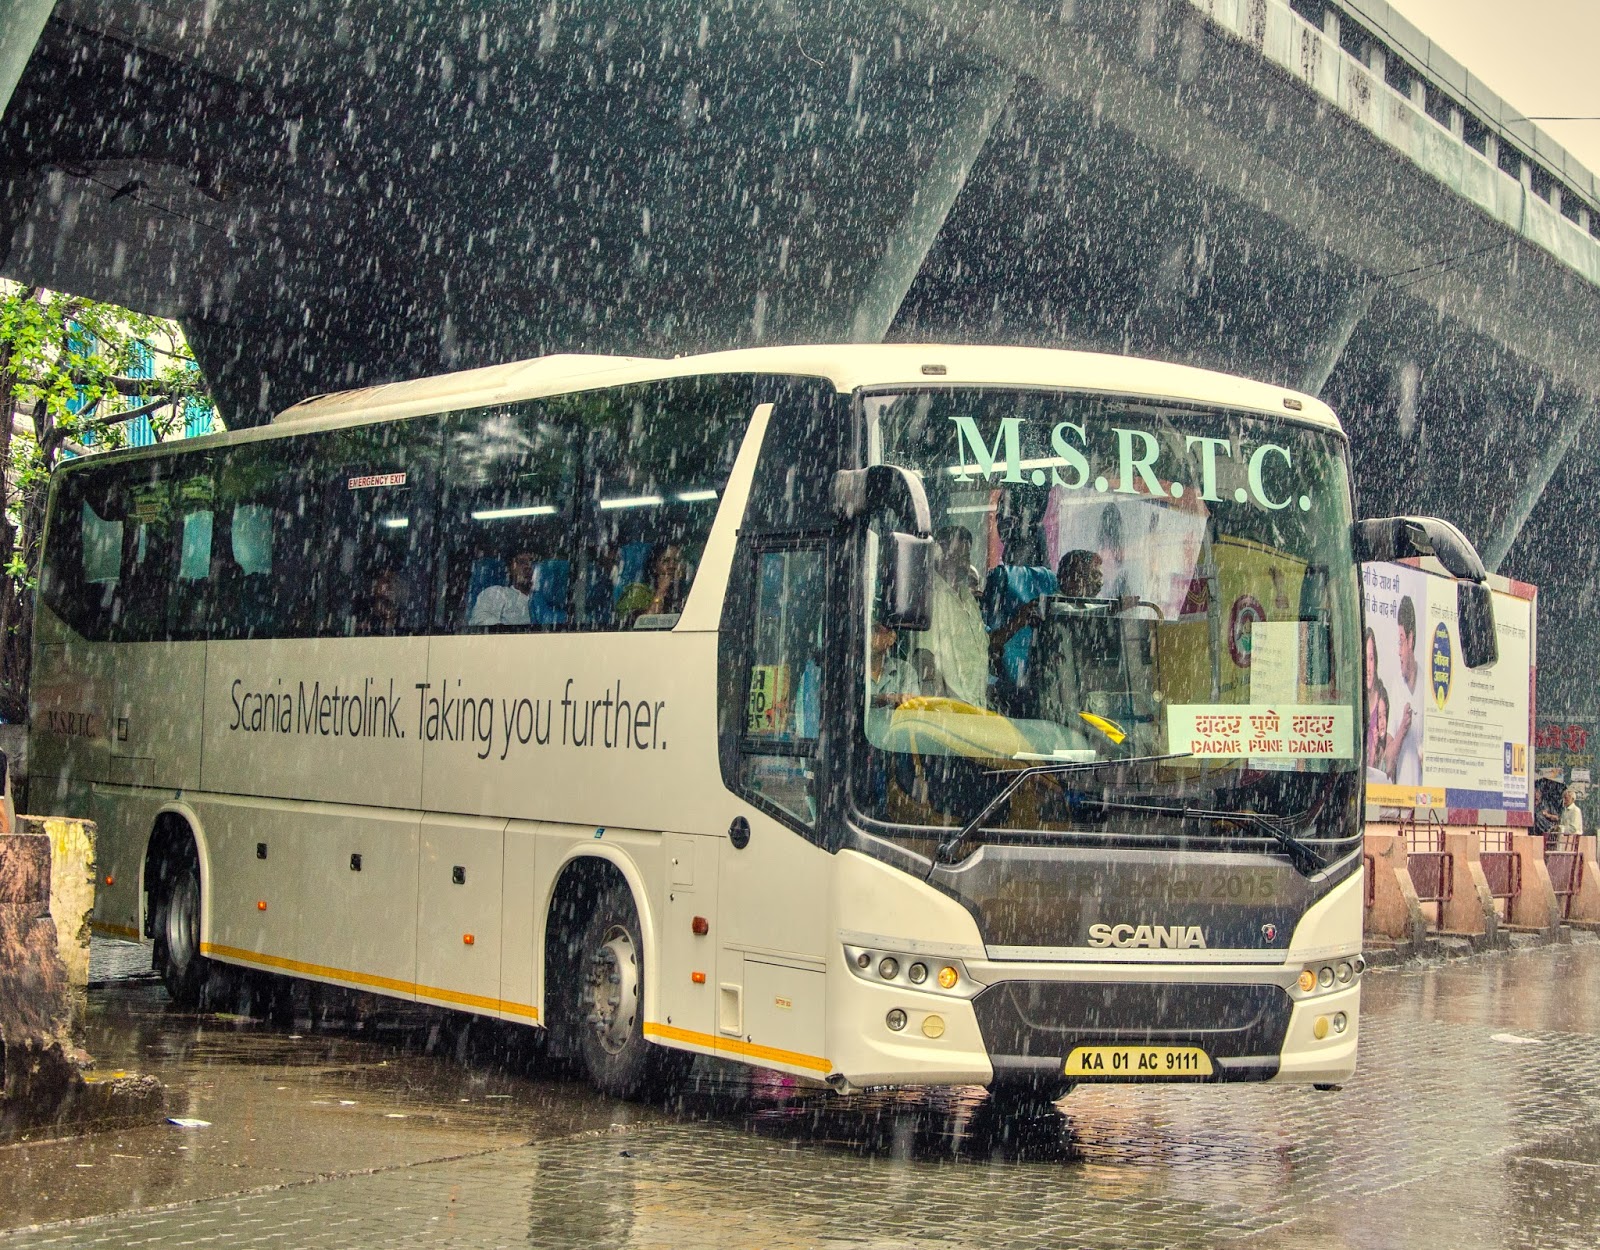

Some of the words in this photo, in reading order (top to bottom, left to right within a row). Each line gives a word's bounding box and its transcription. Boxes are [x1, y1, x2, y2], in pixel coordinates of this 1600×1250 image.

[948, 416, 1311, 511] M.S.R.T.C.
[349, 476, 388, 488] EMERGENCY
[390, 474, 404, 484] EXIT
[1372, 568, 1379, 588] के
[1379, 575, 1391, 591] साथ
[1393, 574, 1400, 594] भी
[1390, 599, 1397, 619] भी
[230, 678, 293, 734] Scania
[297, 677, 405, 739] Metrolink.
[415, 679, 494, 760] Taking
[500, 698, 551, 761] you
[561, 678, 667, 750] further.
[1191, 740, 1242, 753] DADAR
[1249, 740, 1283, 752] PUNE
[1288, 740, 1334, 753] DADAR
[1087, 923, 1207, 949] SCANIA
[1081, 1053, 1104, 1069] KA
[1112, 1053, 1129, 1069] 01
[1138, 1053, 1158, 1069] AC
[1166, 1053, 1198, 1069] 9111
